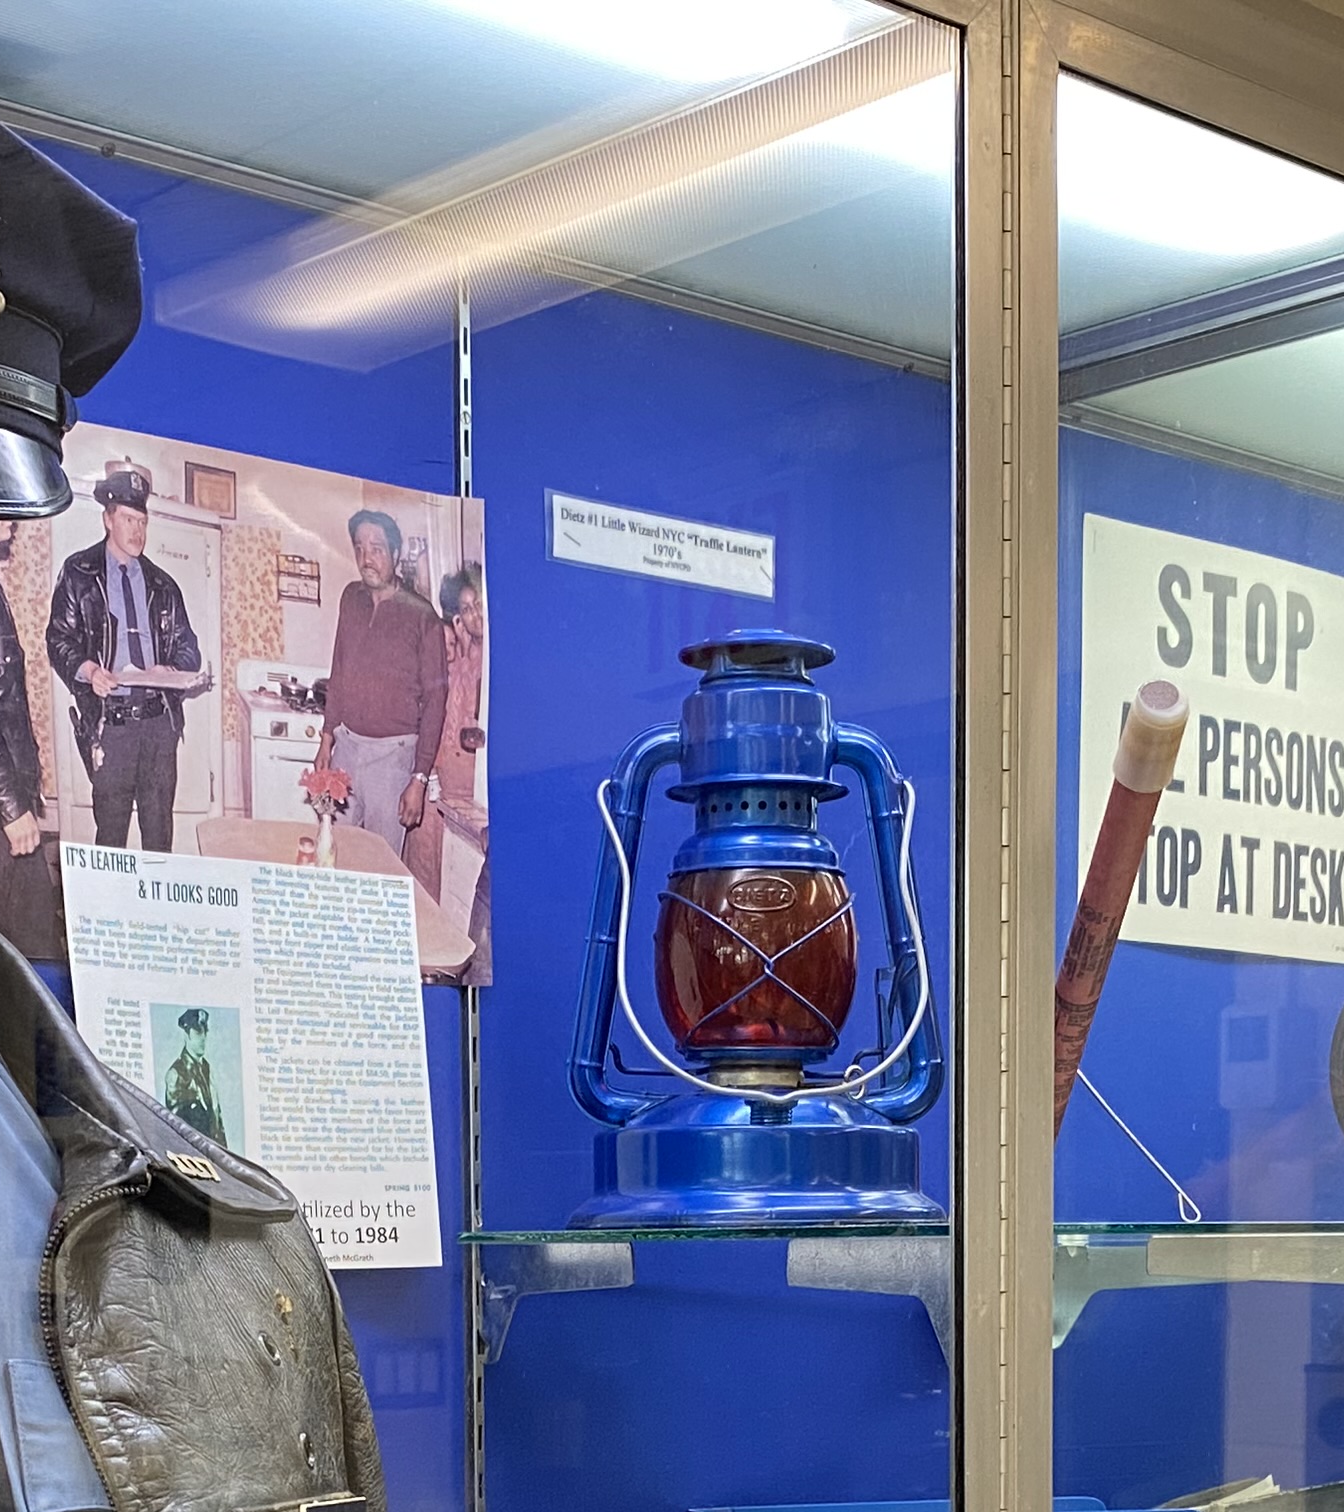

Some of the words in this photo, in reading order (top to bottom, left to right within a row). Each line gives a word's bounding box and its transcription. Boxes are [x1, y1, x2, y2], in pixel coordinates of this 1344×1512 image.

[561, 507, 584, 524] Dietz
[587, 513, 598, 527] #1
[601, 515, 626, 532] Little
[628, 521, 659, 539] Wizard
[662, 527, 685, 543] NYC
[1157, 563, 1314, 691] STOP
[66, 846, 86, 868] IT'S
[91, 848, 137, 875] LEATHER
[1137, 825, 1202, 909] TOP
[1216, 833, 1260, 915] AT
[138, 880, 147, 899] &
[152, 881, 161, 900] IT
[167, 882, 203, 904] LOOKS
[208, 887, 238, 907] GOOD
[303, 1200, 353, 1218] tilized
[360, 1200, 380, 1222] by
[387, 1200, 415, 1218] the
[331, 1230, 349, 1244] to
[356, 1227, 399, 1244] 1984
